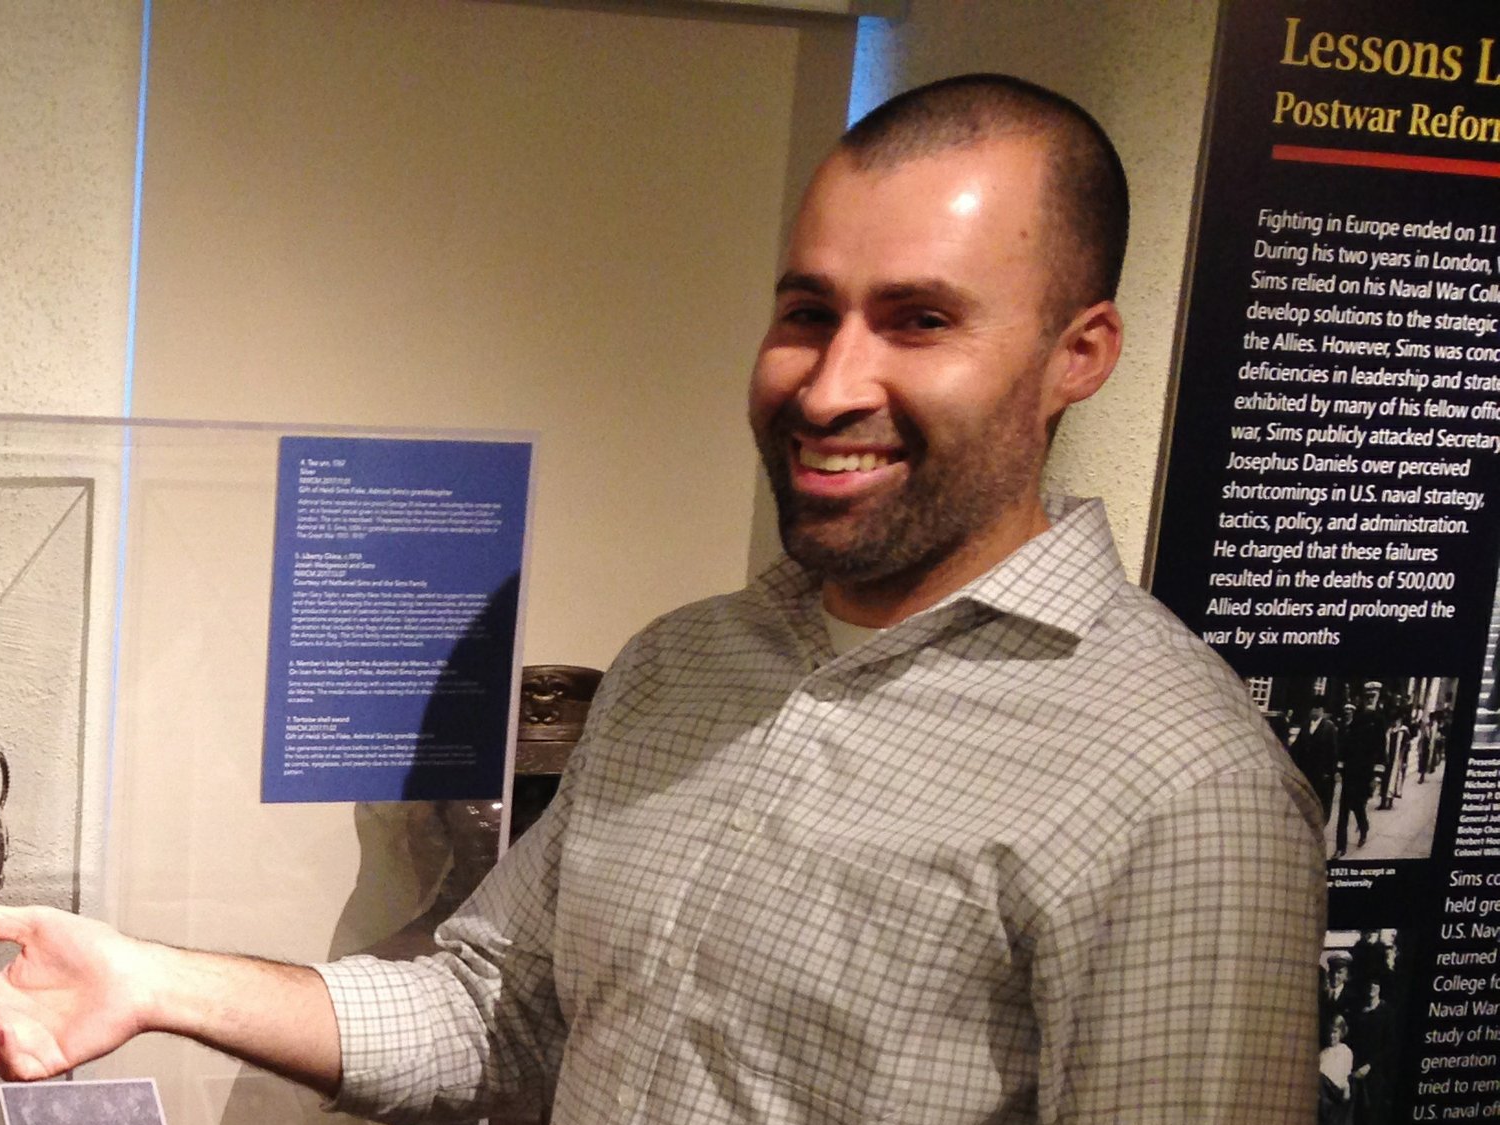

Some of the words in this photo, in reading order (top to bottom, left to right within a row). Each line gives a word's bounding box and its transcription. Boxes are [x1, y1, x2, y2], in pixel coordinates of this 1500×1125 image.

[1280, 17, 1463, 82] Lessons
[1272, 91, 1402, 133] Postwar
[1258, 209, 1323, 235] Fighting
[1327, 213, 1341, 232] in
[1346, 215, 1399, 240] Europe
[1403, 220, 1451, 240] ended
[1454, 227, 1475, 242] on
[1478, 225, 1496, 243] 11
[1254, 240, 1308, 266] During
[1312, 243, 1334, 262] his
[1338, 248, 1368, 265] two
[1371, 251, 1411, 270] years
[1415, 249, 1429, 268] in
[1432, 252, 1492, 274] London,
[1250, 270, 1287, 290] Sims
[1291, 273, 1336, 293] relied
[1339, 278, 1360, 295] on
[1364, 276, 1385, 296] his
[1389, 279, 1432, 298] Naval
[1436, 282, 1466, 301] War
[1246, 301, 1310, 325] develop
[1314, 304, 1382, 326] solutions
[1386, 310, 1403, 327] to
[1406, 310, 1430, 329] the
[1435, 313, 1498, 337] strategic
[1244, 332, 1270, 350] the
[1273, 332, 1317, 352] Allies.
[1322, 336, 1391, 359] However,
[1395, 339, 1430, 357] Sims
[1435, 345, 1463, 360] was
[1238, 362, 1328, 384] deficiencies
[1332, 366, 1348, 384] in
[1351, 365, 1429, 391] leadership
[1431, 371, 1461, 389] and
[1234, 392, 1306, 412] exhibited
[1310, 393, 1330, 416] by
[1333, 399, 1376, 419] many
[1379, 397, 1397, 415] of
[1399, 398, 1420, 417] his
[1423, 398, 1468, 419] fellow
[1231, 426, 1261, 443] war,
[1266, 423, 1303, 442] Sims
[1306, 424, 1366, 448] publicly
[1369, 427, 1434, 446] attacked
[1437, 429, 1500, 453] Secretary
[1225, 452, 1299, 474] Josephus
[1303, 453, 1358, 474] Daniels
[1361, 460, 1394, 474] over
[1397, 459, 1470, 478] perceived
[1222, 481, 1328, 505] shortcomings
[1332, 483, 1346, 501] in
[1350, 484, 1378, 503] U.S.
[1381, 486, 1421, 504] naval
[1424, 489, 1485, 510] strategy,
[1219, 511, 1271, 531] tactics,
[1274, 512, 1323, 535] policy,
[1327, 512, 1357, 531] and
[1359, 513, 1469, 534] administration.
[1213, 540, 1236, 558] He
[1240, 540, 1303, 563] charged
[1306, 540, 1338, 559] that
[1341, 540, 1382, 560] these
[1385, 542, 1438, 562] failures
[1209, 569, 1272, 588] resulted
[1276, 569, 1290, 588] in
[1295, 570, 1319, 589] the
[1323, 570, 1374, 589] deaths
[1377, 571, 1395, 589] of
[1396, 572, 1454, 592] 500,000
[1206, 598, 1251, 616] Allied
[1254, 598, 1314, 617] soldiers
[1317, 598, 1346, 618] and
[1349, 599, 1427, 622] prolonged
[1431, 600, 1455, 618] the
[1204, 630, 1231, 645] war
[1235, 627, 1256, 649] by
[1258, 626, 1278, 645] six
[1282, 626, 1340, 646] months
[1450, 870, 1483, 887] Sims
[1444, 897, 1476, 914] held
[1441, 923, 1466, 940] U.S.
[1436, 949, 1497, 966] returned
[1433, 975, 1486, 995] College
[1429, 1001, 1469, 1018] Naval
[1473, 1001, 1499, 1017] War
[1425, 1029, 1464, 1045] study
[1467, 1026, 1483, 1042] of
[1421, 1053, 1497, 1074] generation
[1418, 1078, 1451, 1095] tried
[1454, 1080, 1469, 1093] to
[1413, 1103, 1438, 1121] U.S.
[1443, 1102, 1480, 1119] naval
